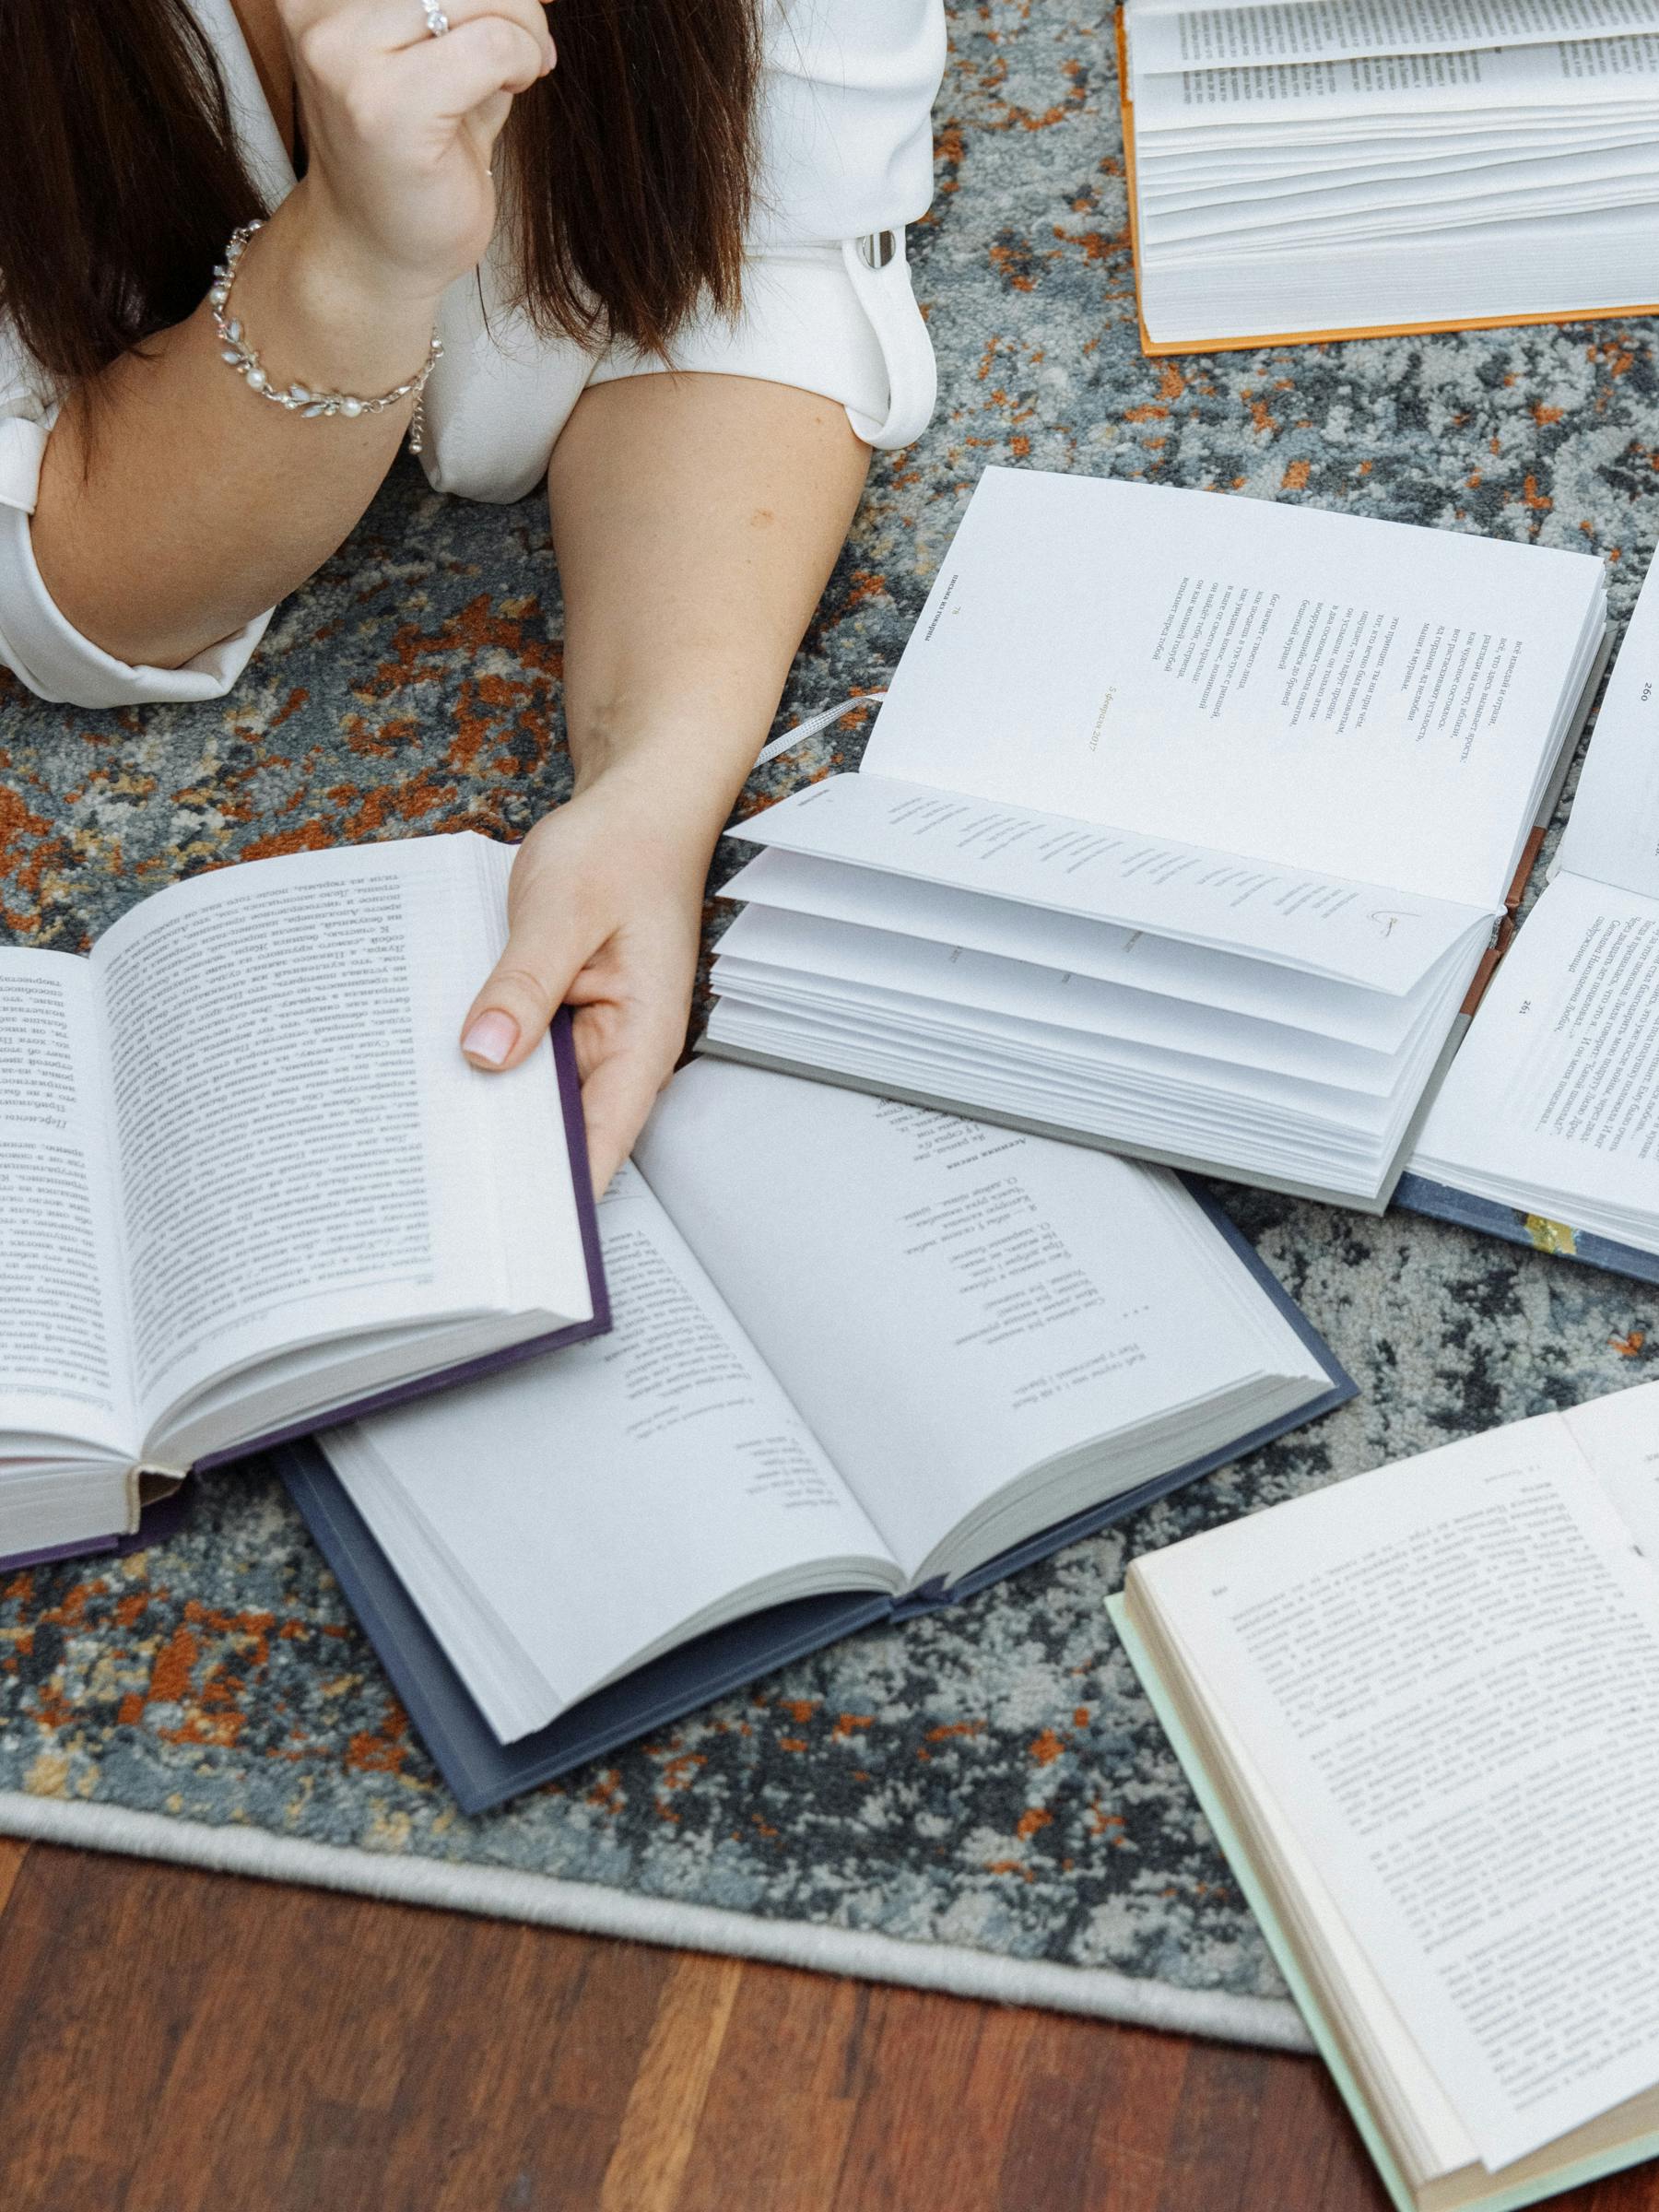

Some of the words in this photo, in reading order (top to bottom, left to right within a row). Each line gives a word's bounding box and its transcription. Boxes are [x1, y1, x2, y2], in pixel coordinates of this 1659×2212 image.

[943, 574, 959, 600] письма
[1170, 577, 1189, 613] вспыхнет
[1194, 579, 1204, 590] он
[1210, 582, 1218, 593] он
[1239, 588, 1249, 602] как
[938, 601, 947, 609] из
[1189, 591, 1200, 604] как
[1199, 593, 1214, 620] найдёт
[1219, 591, 1231, 610] шаге
[1253, 591, 1264, 605] как
[1268, 594, 1280, 607] бог
[1176, 606, 1194, 639] молнией
[1215, 611, 1223, 620] от
[1225, 602, 1243, 636] увидишь
[1241, 606, 1258, 639] поедешь
[1258, 607, 1273, 635] начнёт
[1289, 599, 1310, 635] бешеный
[1326, 610, 1336, 624] два
[1345, 607, 1354, 618] он
[1372, 614, 1384, 628] тот,
[1390, 617, 1399, 629] это
[924, 610, 942, 641] гокарны
[1160, 614, 1175, 636] перед
[1190, 621, 1204, 641] тебя,
[1205, 621, 1219, 647] своего
[1295, 602, 1324, 665] вооружившийся
[1416, 622, 1430, 647] мыши
[1435, 625, 1445, 635] яд
[1451, 629, 1461, 642] вот
[1312, 626, 1331, 663] сосновых
[1368, 629, 1378, 644] кто
[1466, 631, 1477, 646] как
[1495, 637, 1507, 653] всё,
[1512, 641, 1523, 654] всё
[1151, 637, 1166, 660] тобой
[1163, 640, 1181, 672] голубой
[1214, 638, 1230, 662] кокос,
[1245, 642, 1260, 668] твоего
[1345, 649, 1355, 663] что
[1359, 645, 1373, 668] вечно
[1422, 636, 1441, 672] гордыни,
[1474, 634, 1491, 670] разгляди
[1226, 646, 1242, 678] тук-туке
[1291, 665, 1300, 677] до
[1326, 657, 1335, 668] он
[1431, 642, 1455, 700] растаскивают
[1453, 647, 1471, 683] чудесное
[1491, 654, 1501, 668] что
[1500, 655, 1518, 688] изведай
[1301, 664, 1317, 690] ствола
[1316, 669, 1332, 697] только
[1336, 664, 1349, 687] вдруг
[1353, 669, 1366, 686] был
[1371, 670, 1381, 680] ты
[1418, 674, 1428, 684] яд
[1470, 671, 1478, 681] на
[1484, 669, 1496, 690] здесь
[1198, 664, 1219, 709] возникший
[1280, 677, 1298, 706] бровей
[1367, 682, 1376, 693] ни
[1460, 682, 1475, 705] свету,
[1641, 682, 1652, 701] 260
[1094, 693, 1113, 729] февраля
[1335, 687, 1358, 735] виноватым,
[1361, 694, 1371, 711] при
[1406, 685, 1425, 721] нелюбви
[1470, 692, 1488, 731] вызывает
[1415, 700, 1436, 742] усталость,
[1450, 707, 1466, 738] вблизи,
[1088, 730, 1100, 751] 2017
[1622, 916, 1641, 933] Через
[1637, 920, 1656, 935] Тогда
[1594, 920, 1621, 954] Светлана
[1603, 932, 1627, 966] двадцать
[1639, 944, 1653, 960] этот
[1595, 966, 1607, 981] лет
[1607, 941, 1639, 986] призналась,
[1642, 965, 1657, 982] стал
[1570, 954, 1601, 1002] Николаевна
[1618, 960, 1643, 996] шоколад.
[1519, 1000, 1531, 1014] 261
[1601, 989, 1613, 1004] что
[1553, 1002, 1575, 1032] Любич,
[1593, 1005, 1606, 1019] это
[1608, 998, 1626, 1020] Лиля
[1618, 983, 1650, 1035] благодарить
[1639, 1008, 1652, 1023] это
[1581, 1037, 1592, 1045] И
[1630, 1023, 1644, 1040] уже
[1574, 1046, 1584, 1057] он
[1606, 1037, 1622, 1056] мою
[1562, 1058, 1579, 1079] меня
[1627, 1042, 1652, 1079] подушку
[1588, 1057, 1612, 1091] подругу
[1602, 1066, 1623, 1096] войны,
[1577, 1090, 1595, 1115] Лилю
[1631, 1085, 1649, 1102] Ему
[1591, 1098, 1607, 1121] через
[1621, 1103, 1640, 1125] было
[1601, 1124, 1613, 1134] И
[1608, 1126, 1626, 1151] очень
[1594, 1133, 1606, 1148] вот
[1638, 1130, 1657, 1159] кулаке
